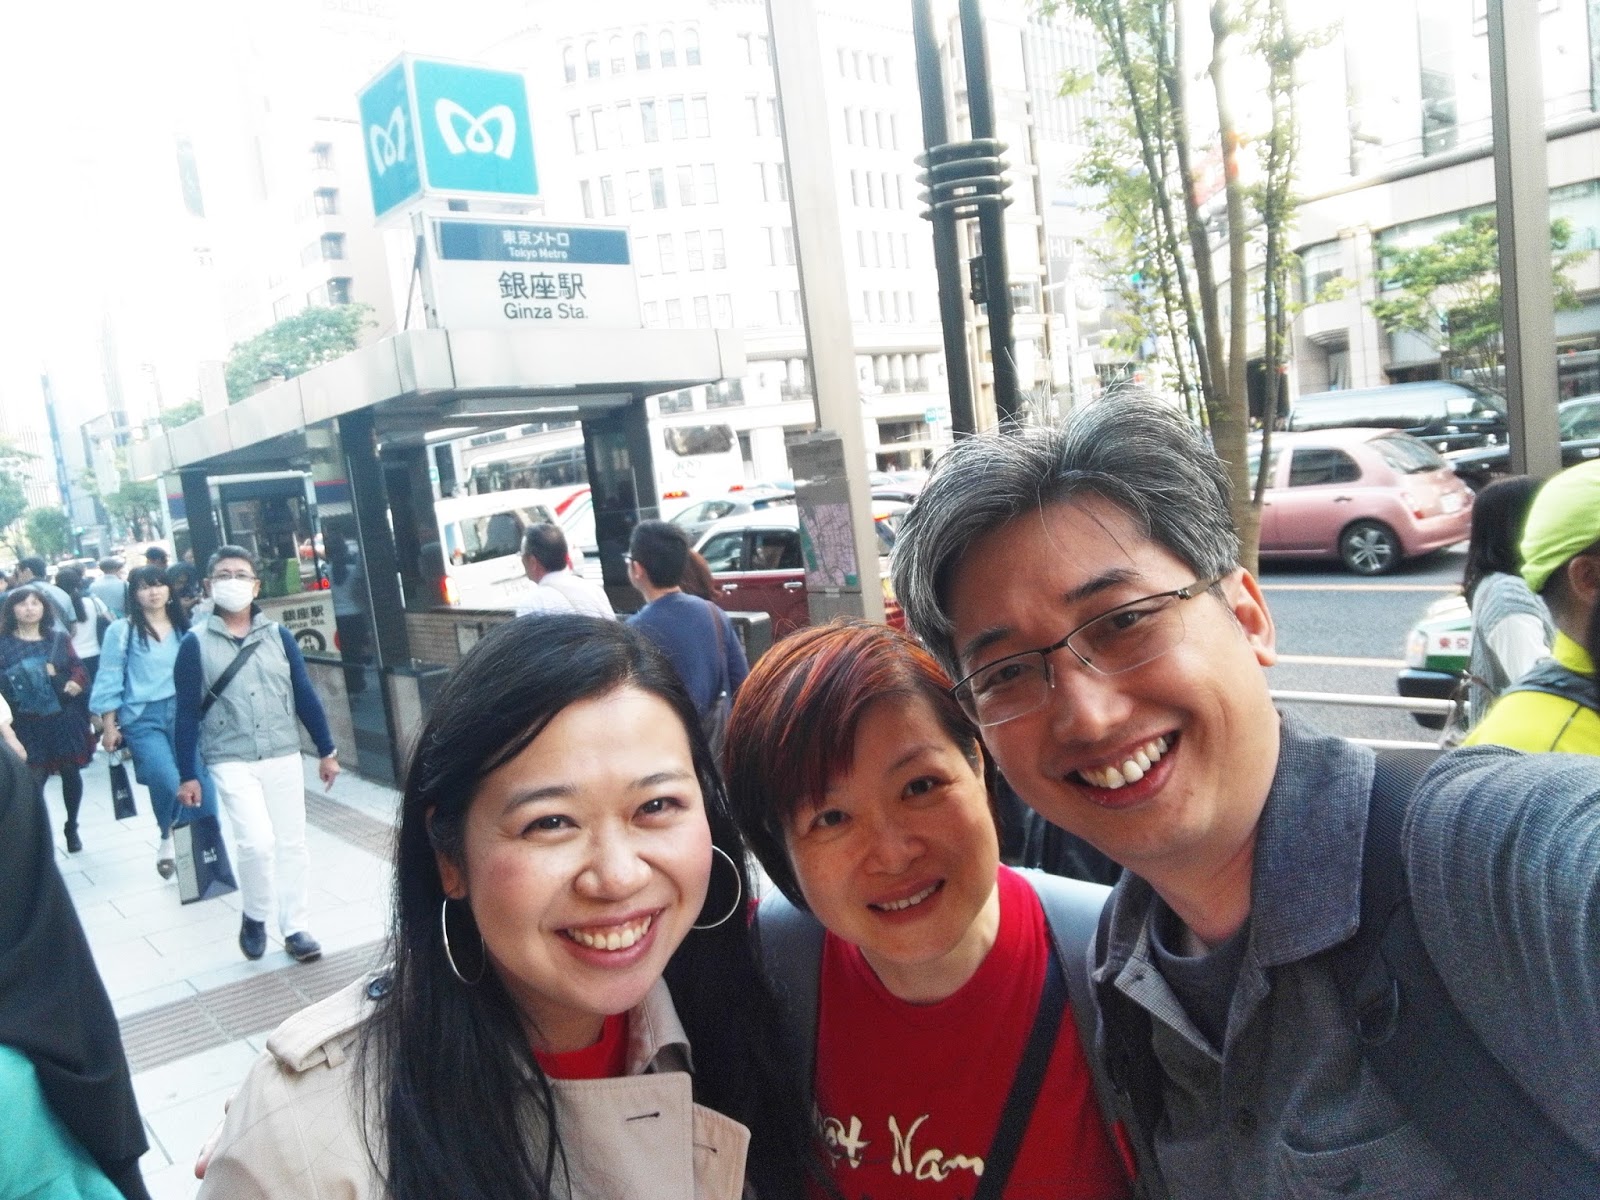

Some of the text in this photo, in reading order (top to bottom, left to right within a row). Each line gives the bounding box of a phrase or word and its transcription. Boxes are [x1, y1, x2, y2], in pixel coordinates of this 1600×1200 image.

[502, 230, 570, 246] 東京メトロ
[509, 247, 568, 259] Tokyo Metro
[498, 270, 587, 299] 銀座駅
[503, 302, 589, 319] Ginza Sta.
[888, 1113, 985, 1182] Nam
